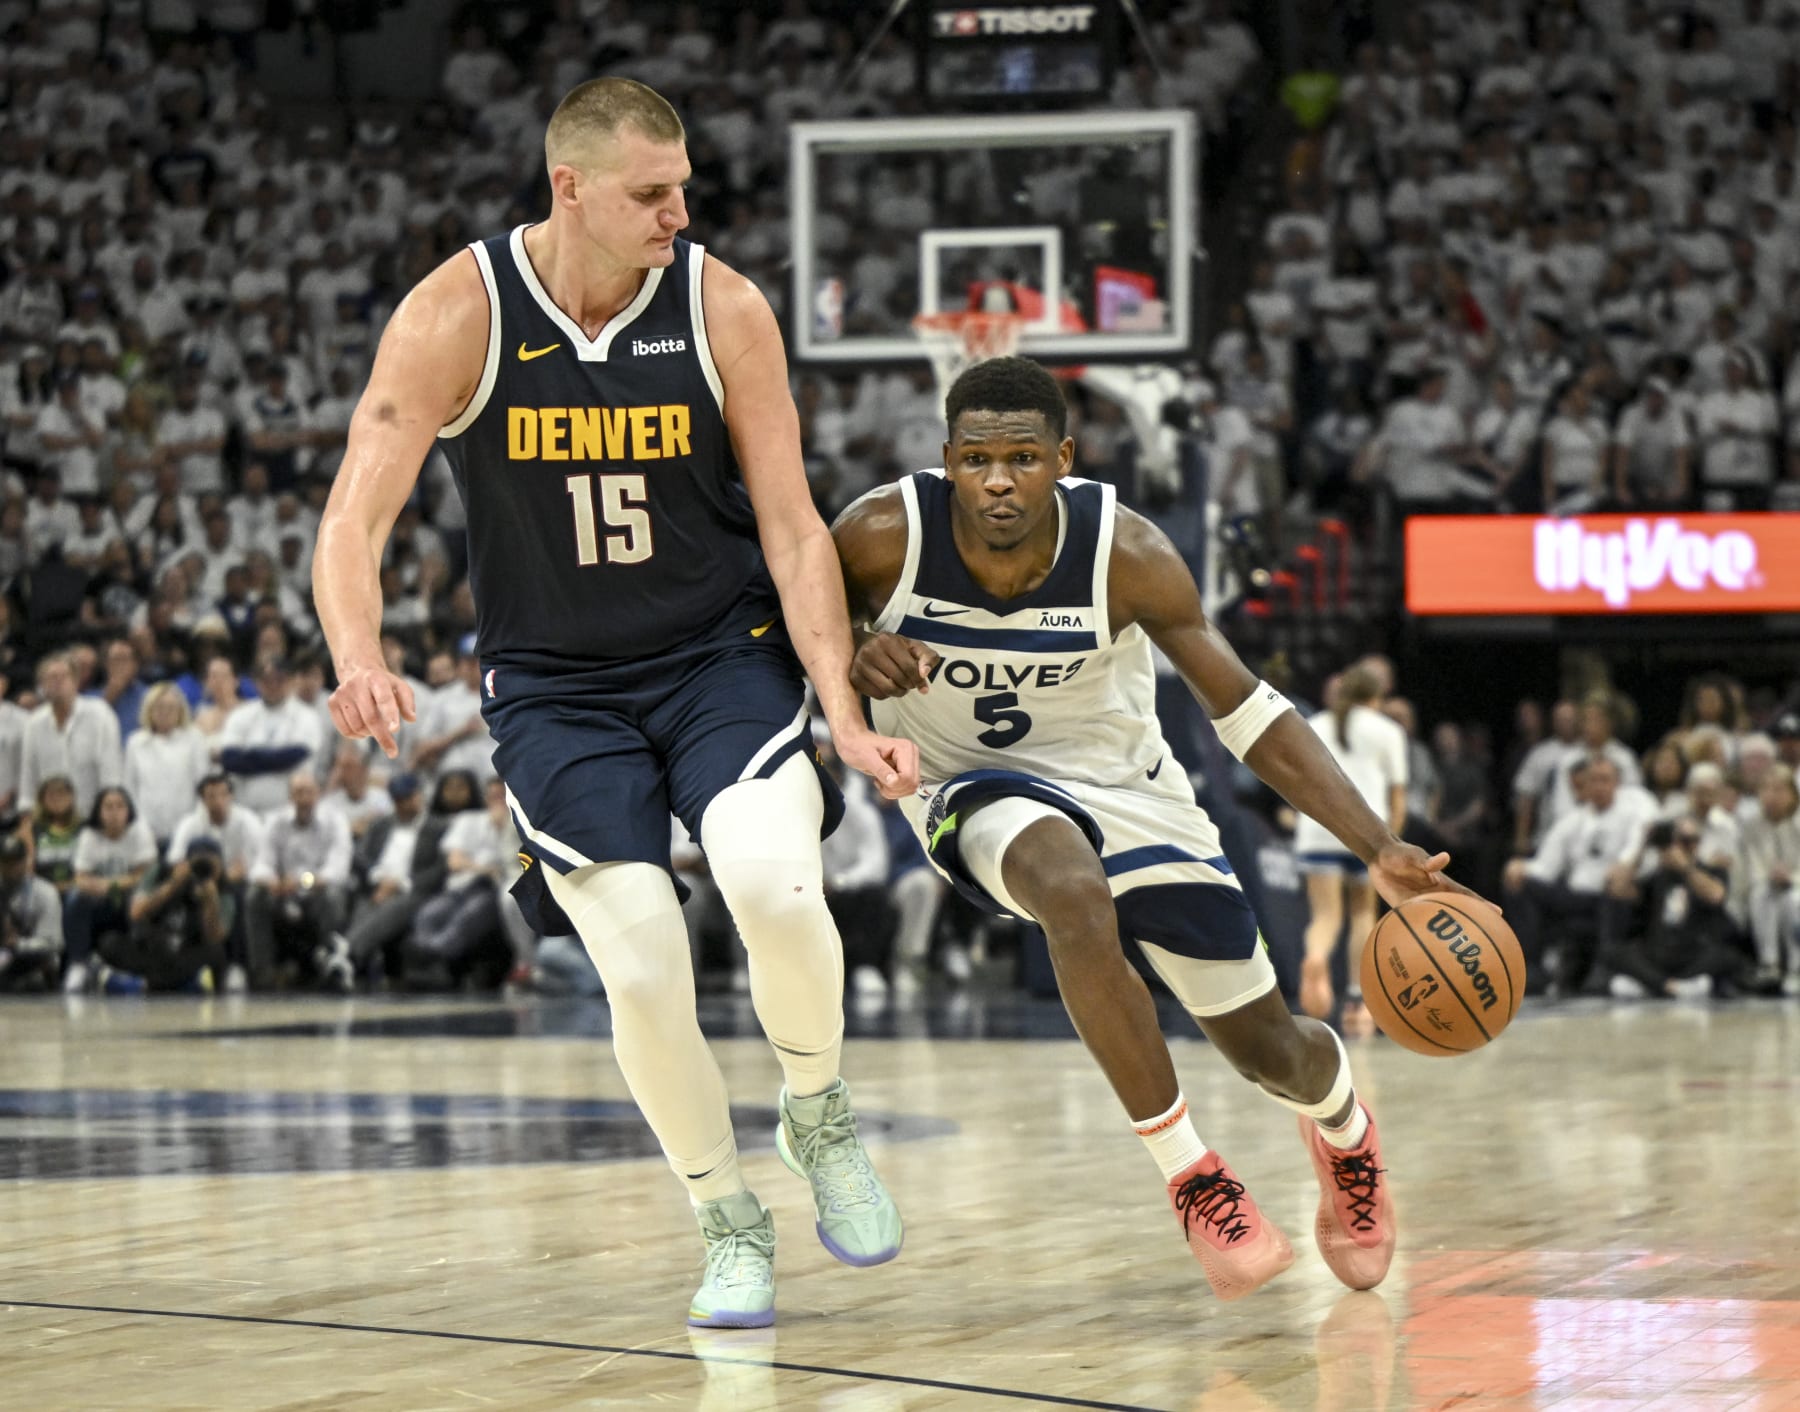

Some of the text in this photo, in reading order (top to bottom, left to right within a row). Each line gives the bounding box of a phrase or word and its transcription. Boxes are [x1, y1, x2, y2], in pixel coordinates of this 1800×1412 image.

[979, 7, 1095, 34] TISSOT
[632, 339, 686, 356] ibotta
[507, 404, 692, 461] DENVER
[565, 472, 653, 567] 15
[974, 691, 1032, 749] 5
[1426, 908, 1498, 1012] Wilson
